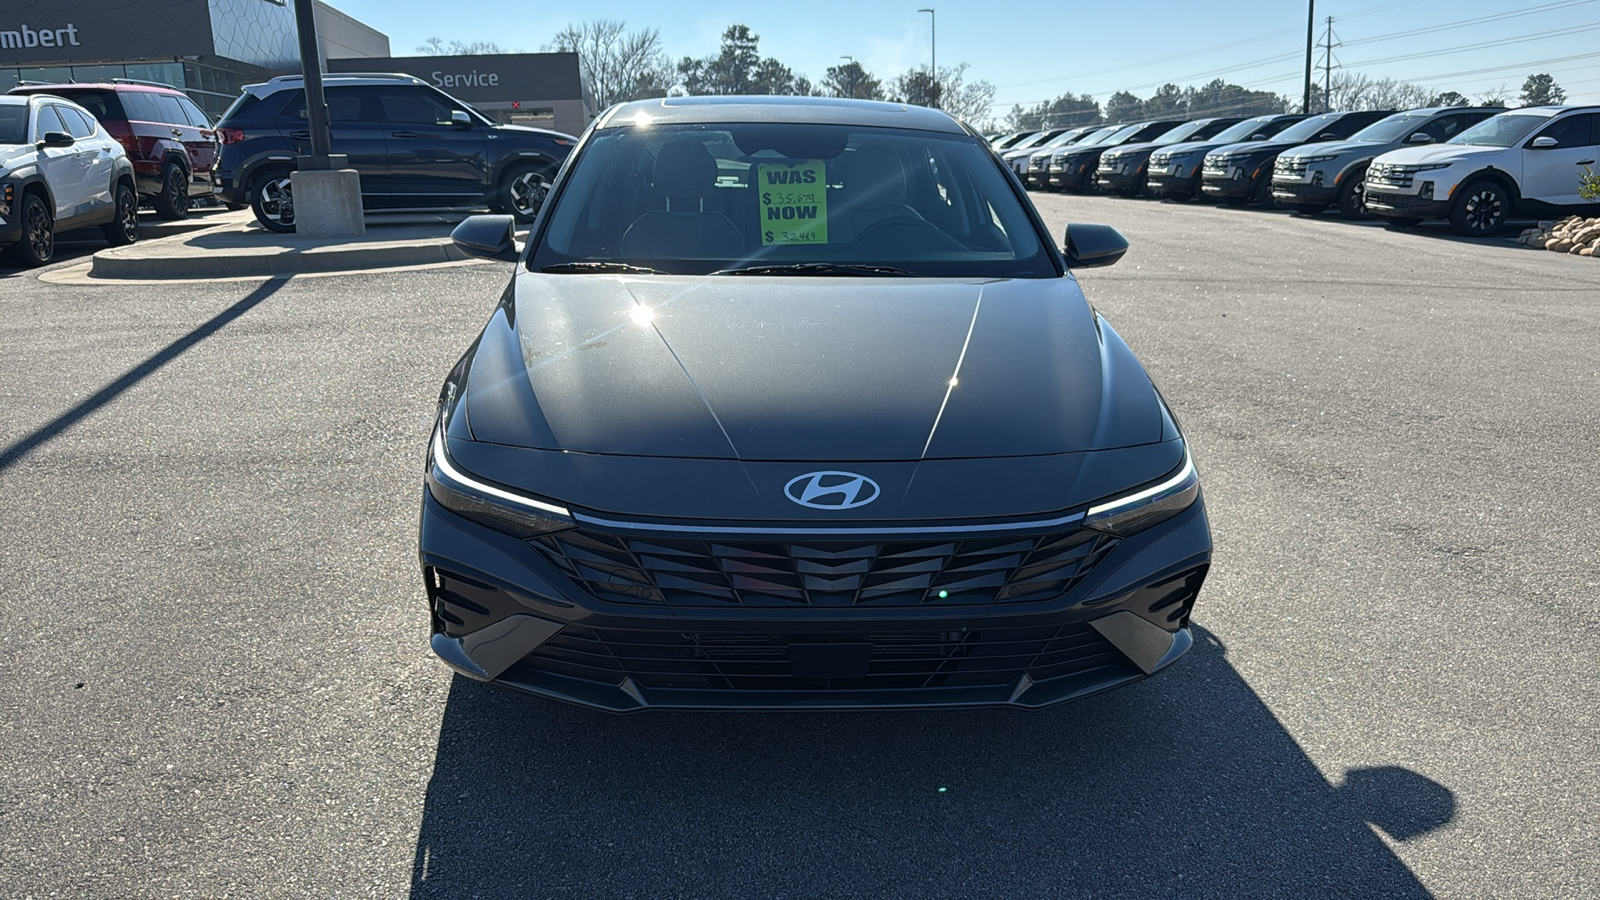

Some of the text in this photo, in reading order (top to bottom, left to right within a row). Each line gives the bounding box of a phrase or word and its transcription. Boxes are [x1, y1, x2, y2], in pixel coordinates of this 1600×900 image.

[431, 70, 499, 88] Service
[766, 170, 816, 184] WAS
[762, 192, 772, 205] $
[767, 206, 818, 220] NOW
[765, 230, 774, 243] $
